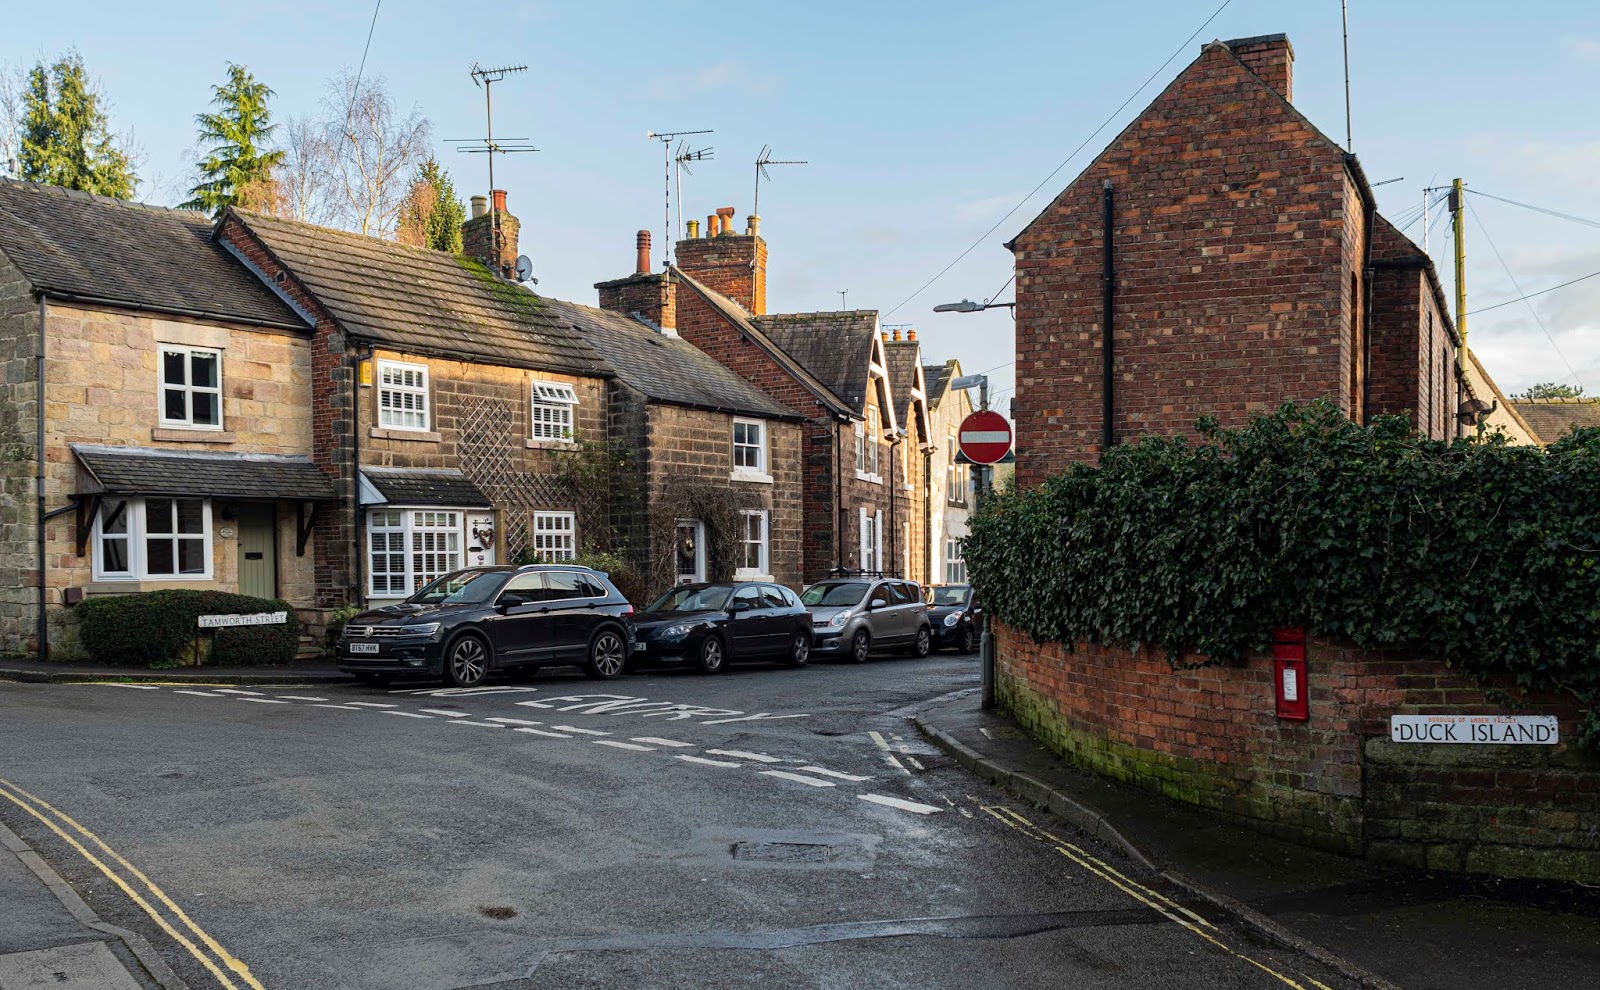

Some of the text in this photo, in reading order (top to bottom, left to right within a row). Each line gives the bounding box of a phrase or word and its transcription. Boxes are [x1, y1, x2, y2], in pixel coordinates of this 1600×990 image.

[203, 614, 284, 626] TAMWORTH STREET
[352, 644, 365, 652] BT67
[514, 694, 811, 724] ENTRY
[1399, 723, 1550, 742] DUCK ISLAND
